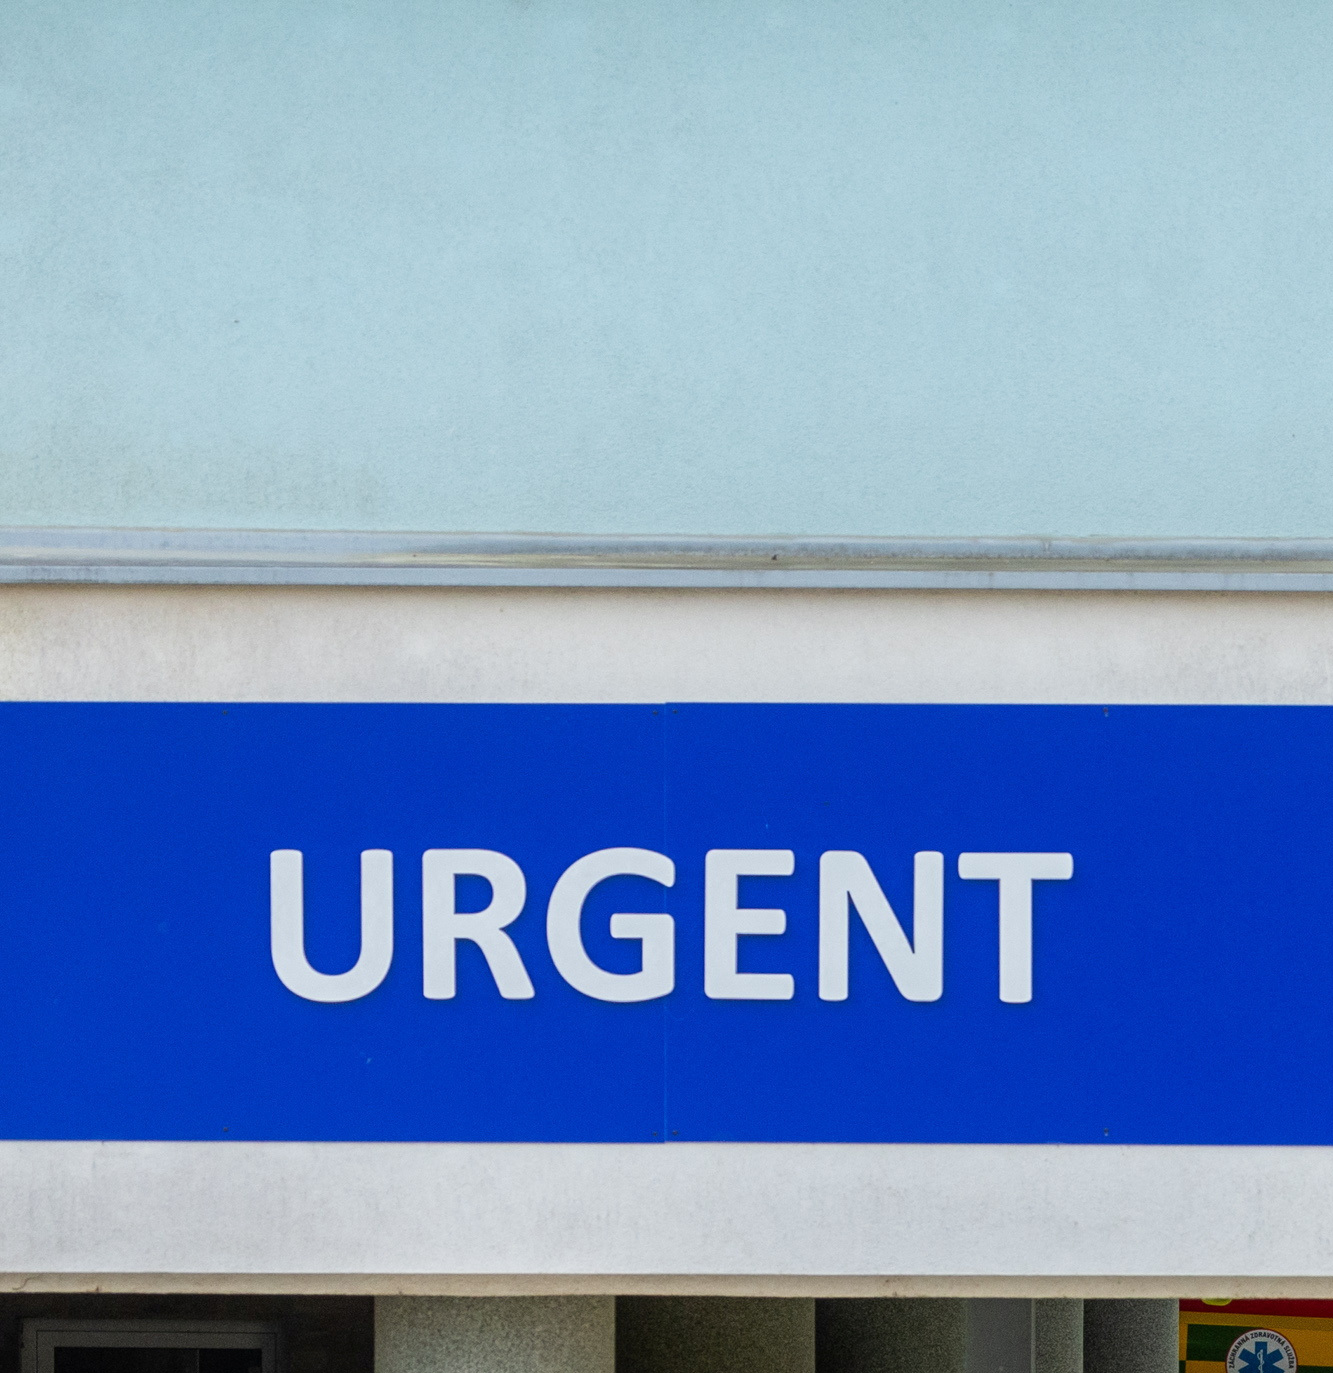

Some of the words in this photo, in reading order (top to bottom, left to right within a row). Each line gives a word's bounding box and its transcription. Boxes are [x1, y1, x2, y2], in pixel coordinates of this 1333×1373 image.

[270, 847, 1073, 1003] URGENT
[1250, 1331, 1285, 1347] ZDRAVOTNÁ
[1283, 1345, 1295, 1369] SLUŽBA
